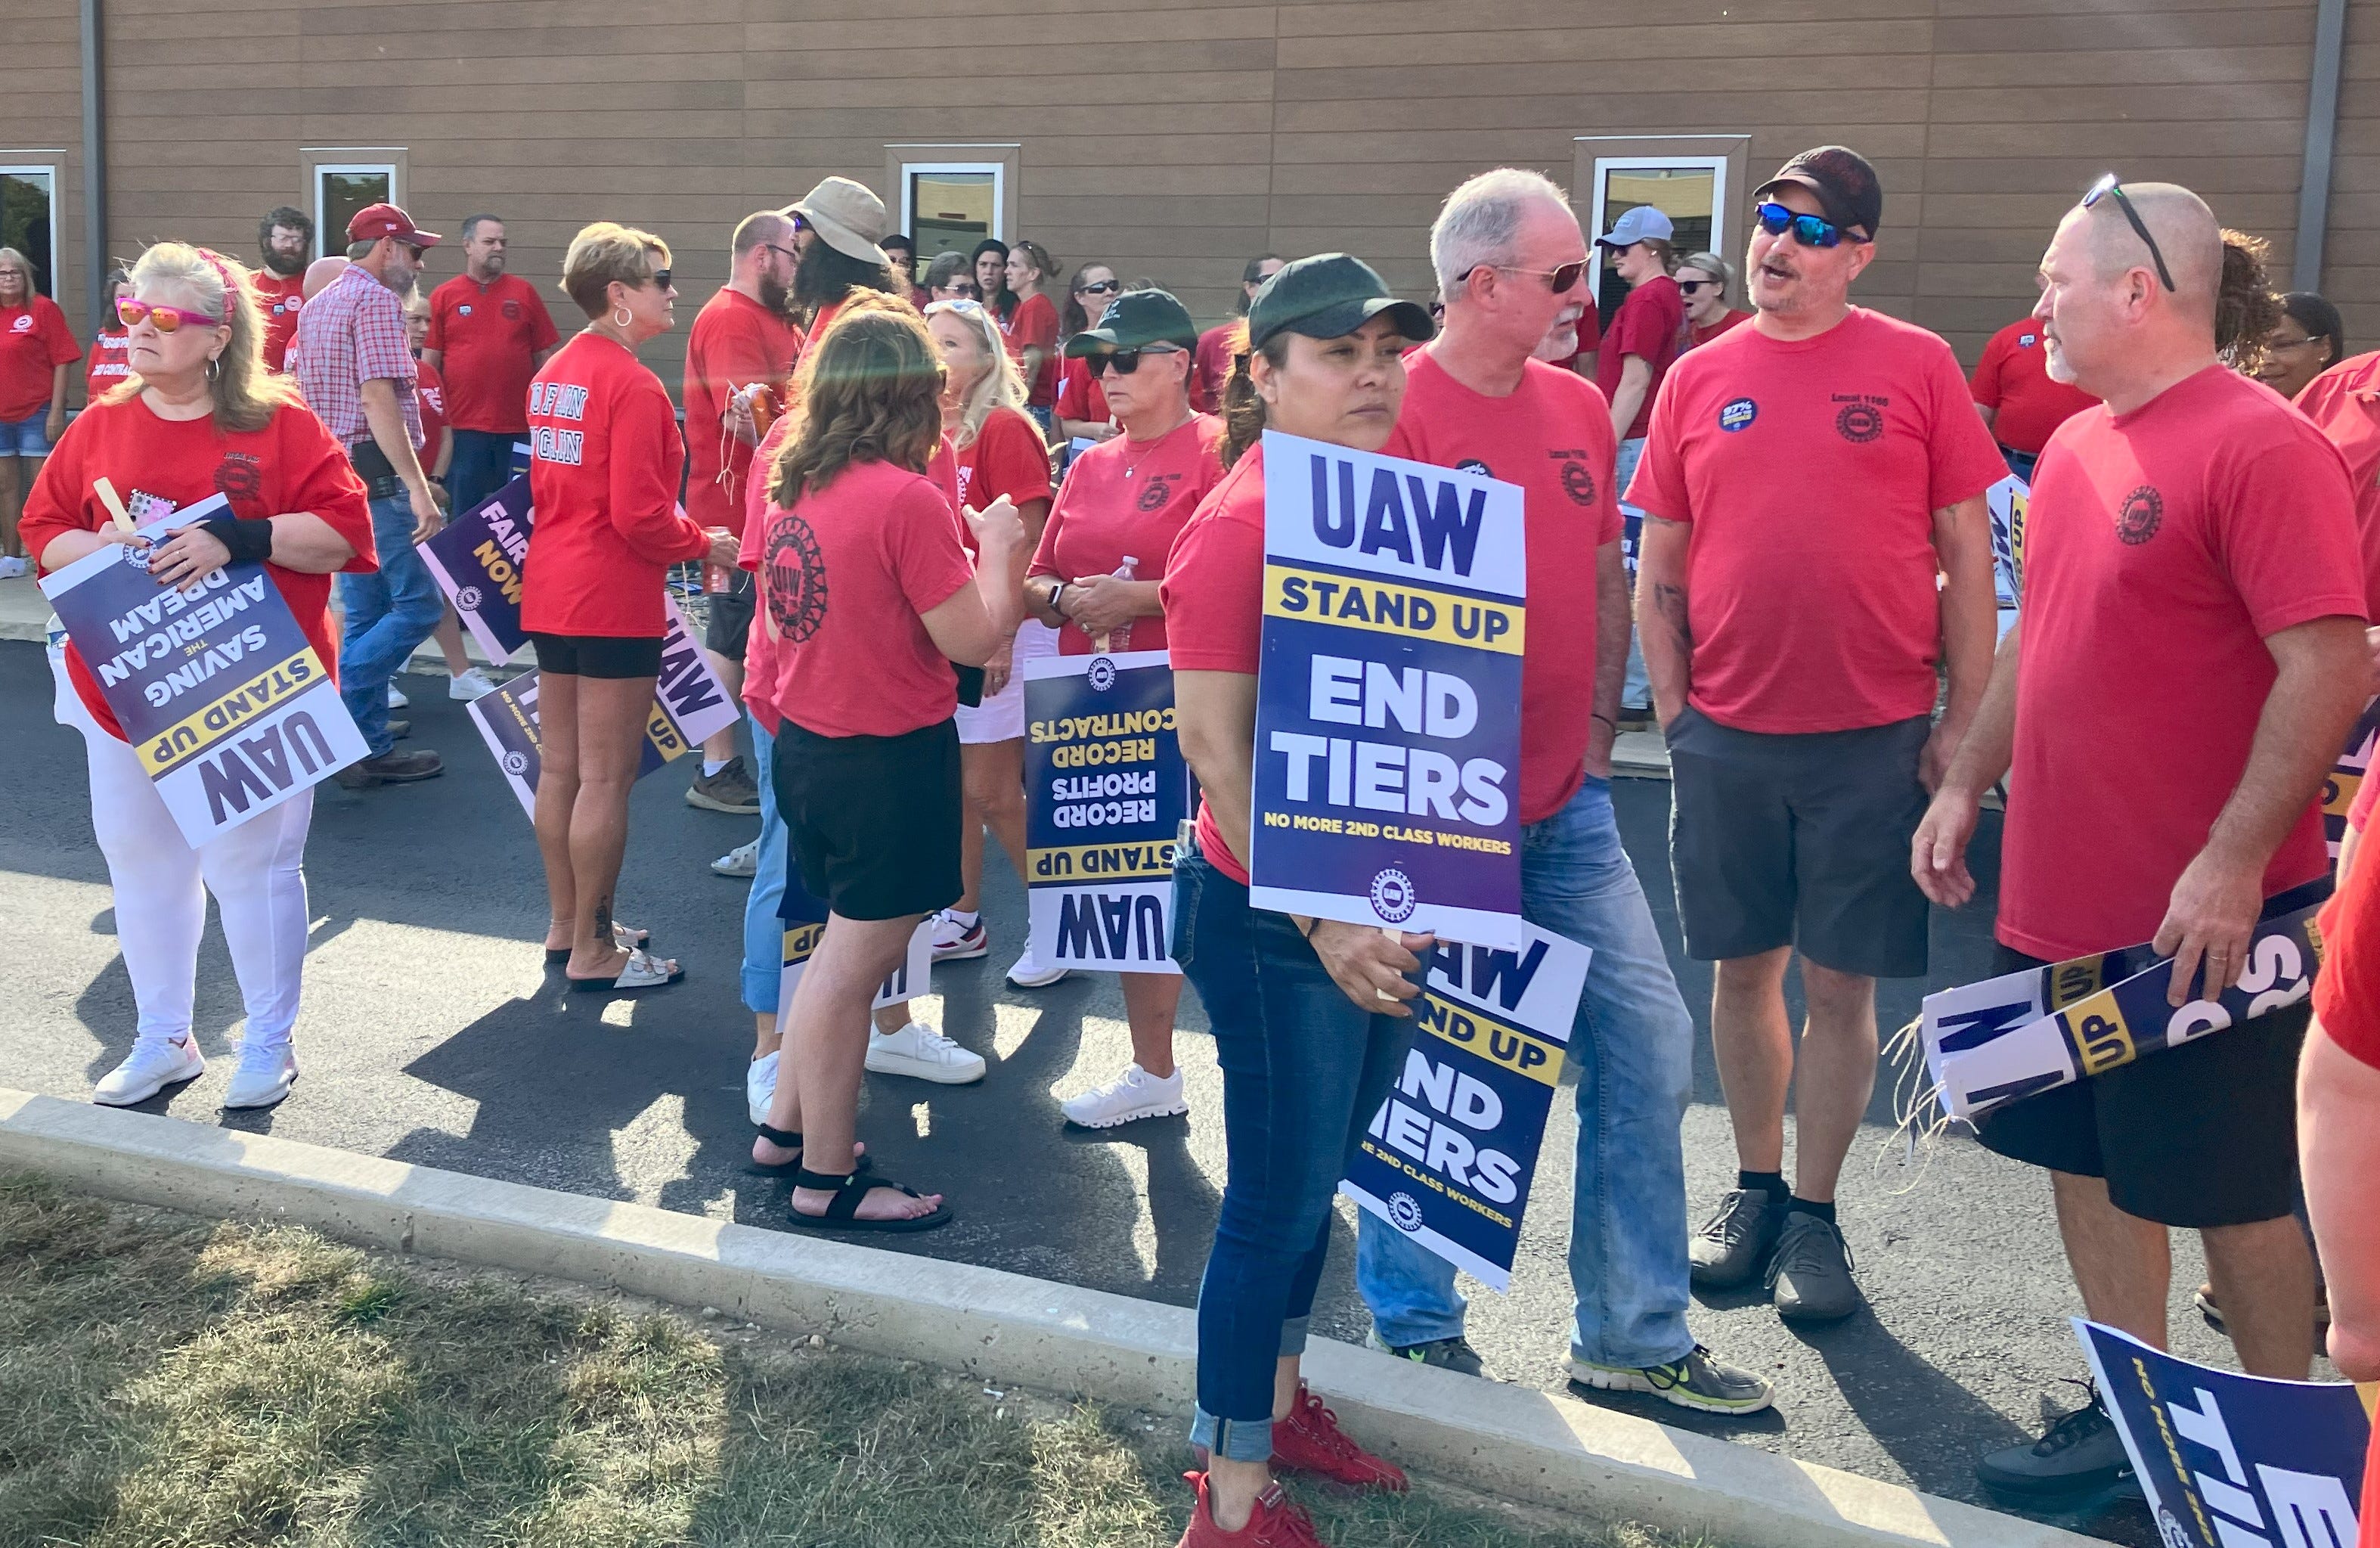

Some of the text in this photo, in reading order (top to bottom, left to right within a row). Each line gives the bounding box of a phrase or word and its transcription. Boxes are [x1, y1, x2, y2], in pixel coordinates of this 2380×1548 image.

[480, 501, 529, 566] FAIR
[1310, 454, 1486, 577] UAW
[97, 574, 265, 687] AMERICAN
[1280, 576, 1510, 643] STAND UP
[144, 625, 267, 708] SAVING
[184, 639, 207, 656] THE
[153, 658, 311, 763] STAND UP
[1030, 707, 1178, 744] CONTRACTS
[1309, 653, 1478, 740] END
[649, 718, 678, 750] UP
[1052, 738, 1155, 768] RECORD
[197, 711, 336, 826] UAW
[1052, 770, 1156, 801] PROFITS
[1269, 731, 1508, 827] TIERS
[1053, 799, 1157, 828] RECORD
[1264, 811, 1512, 855] NO MORE 2ND CLASS WORKERS
[1037, 845, 1176, 876] STAND UP
[1056, 894, 1167, 961] UAW
[1427, 938, 1551, 1013] AW
[2059, 965, 2095, 1003] UP
[1489, 1028, 1547, 1070] UP
[2081, 1013, 2127, 1070] UP
[1396, 1047, 1503, 1131] ND
[1368, 1097, 1521, 1205] ERS
[1376, 1149, 1402, 1168] 2ND
[1403, 1164, 1444, 1193] CLASS
[1446, 1187, 1513, 1229] WORKERS
[2132, 1357, 2156, 1400] NO
[2150, 1404, 2191, 1487] MORE
